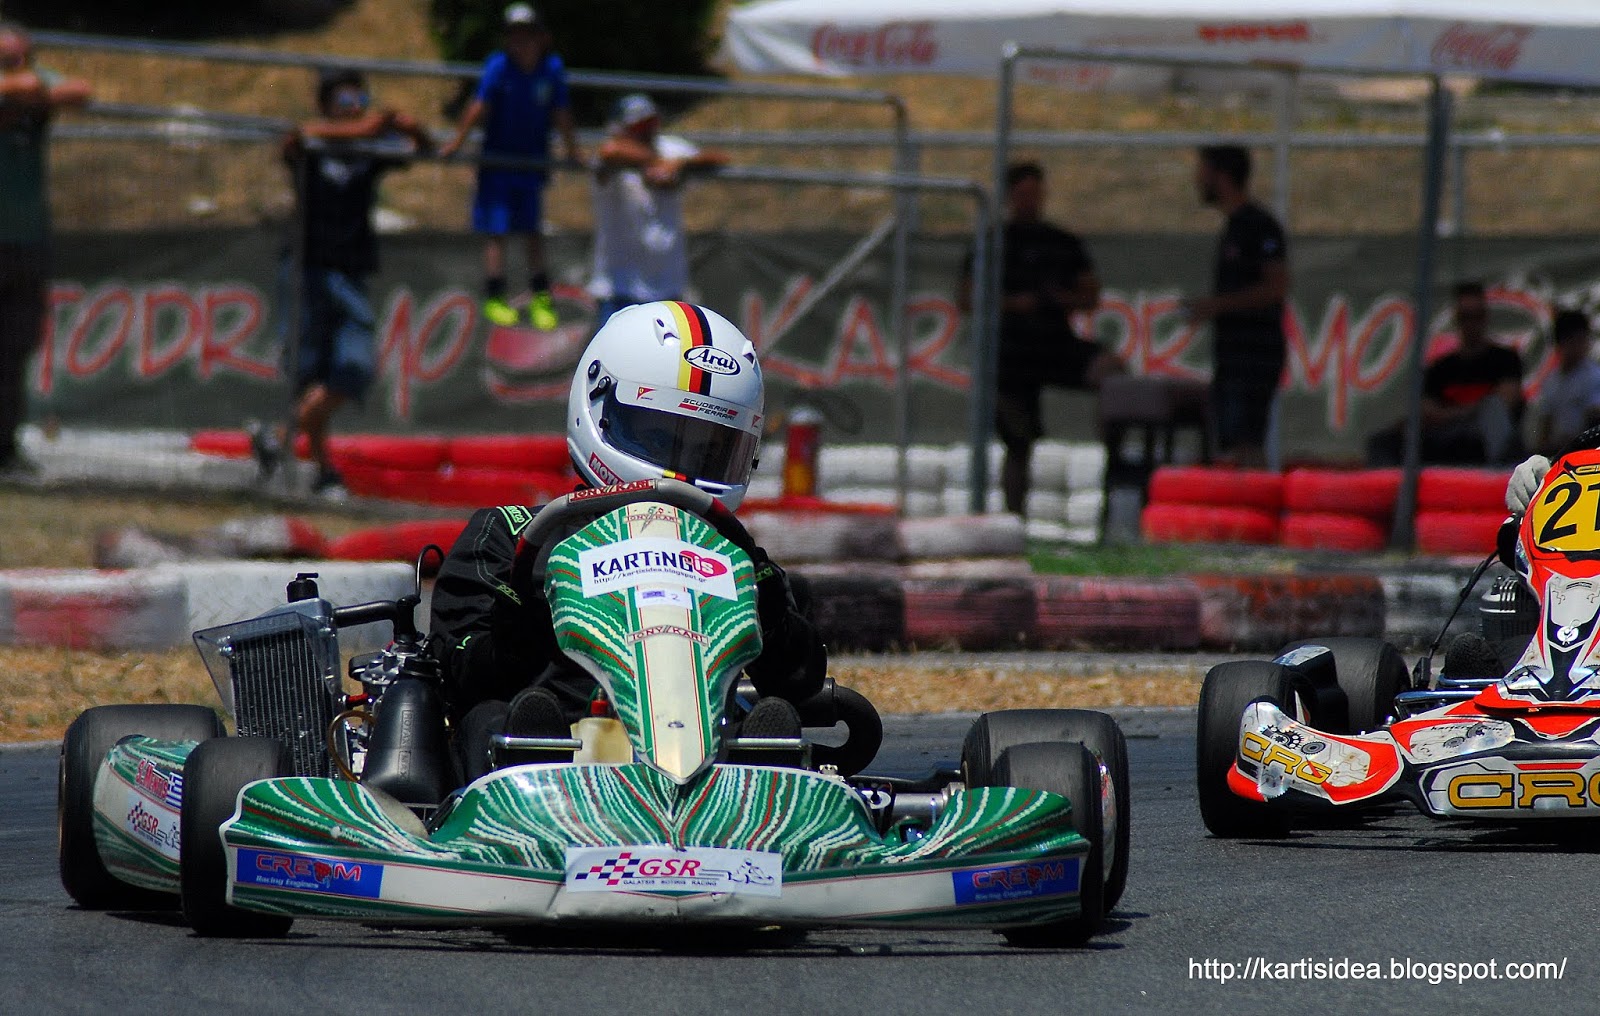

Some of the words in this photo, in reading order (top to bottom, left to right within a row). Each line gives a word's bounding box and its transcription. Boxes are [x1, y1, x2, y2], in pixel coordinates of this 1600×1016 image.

[688, 349, 736, 371] Arai
[682, 397, 728, 413] SCUDERIA
[698, 408, 735, 420] FERRARI
[632, 625, 664, 642] TONY
[672, 626, 704, 642] KART
[1242, 731, 1334, 786] CRG
[1448, 772, 1600, 809] CR
[142, 812, 159, 835] GSR
[638, 859, 701, 877] GSR
